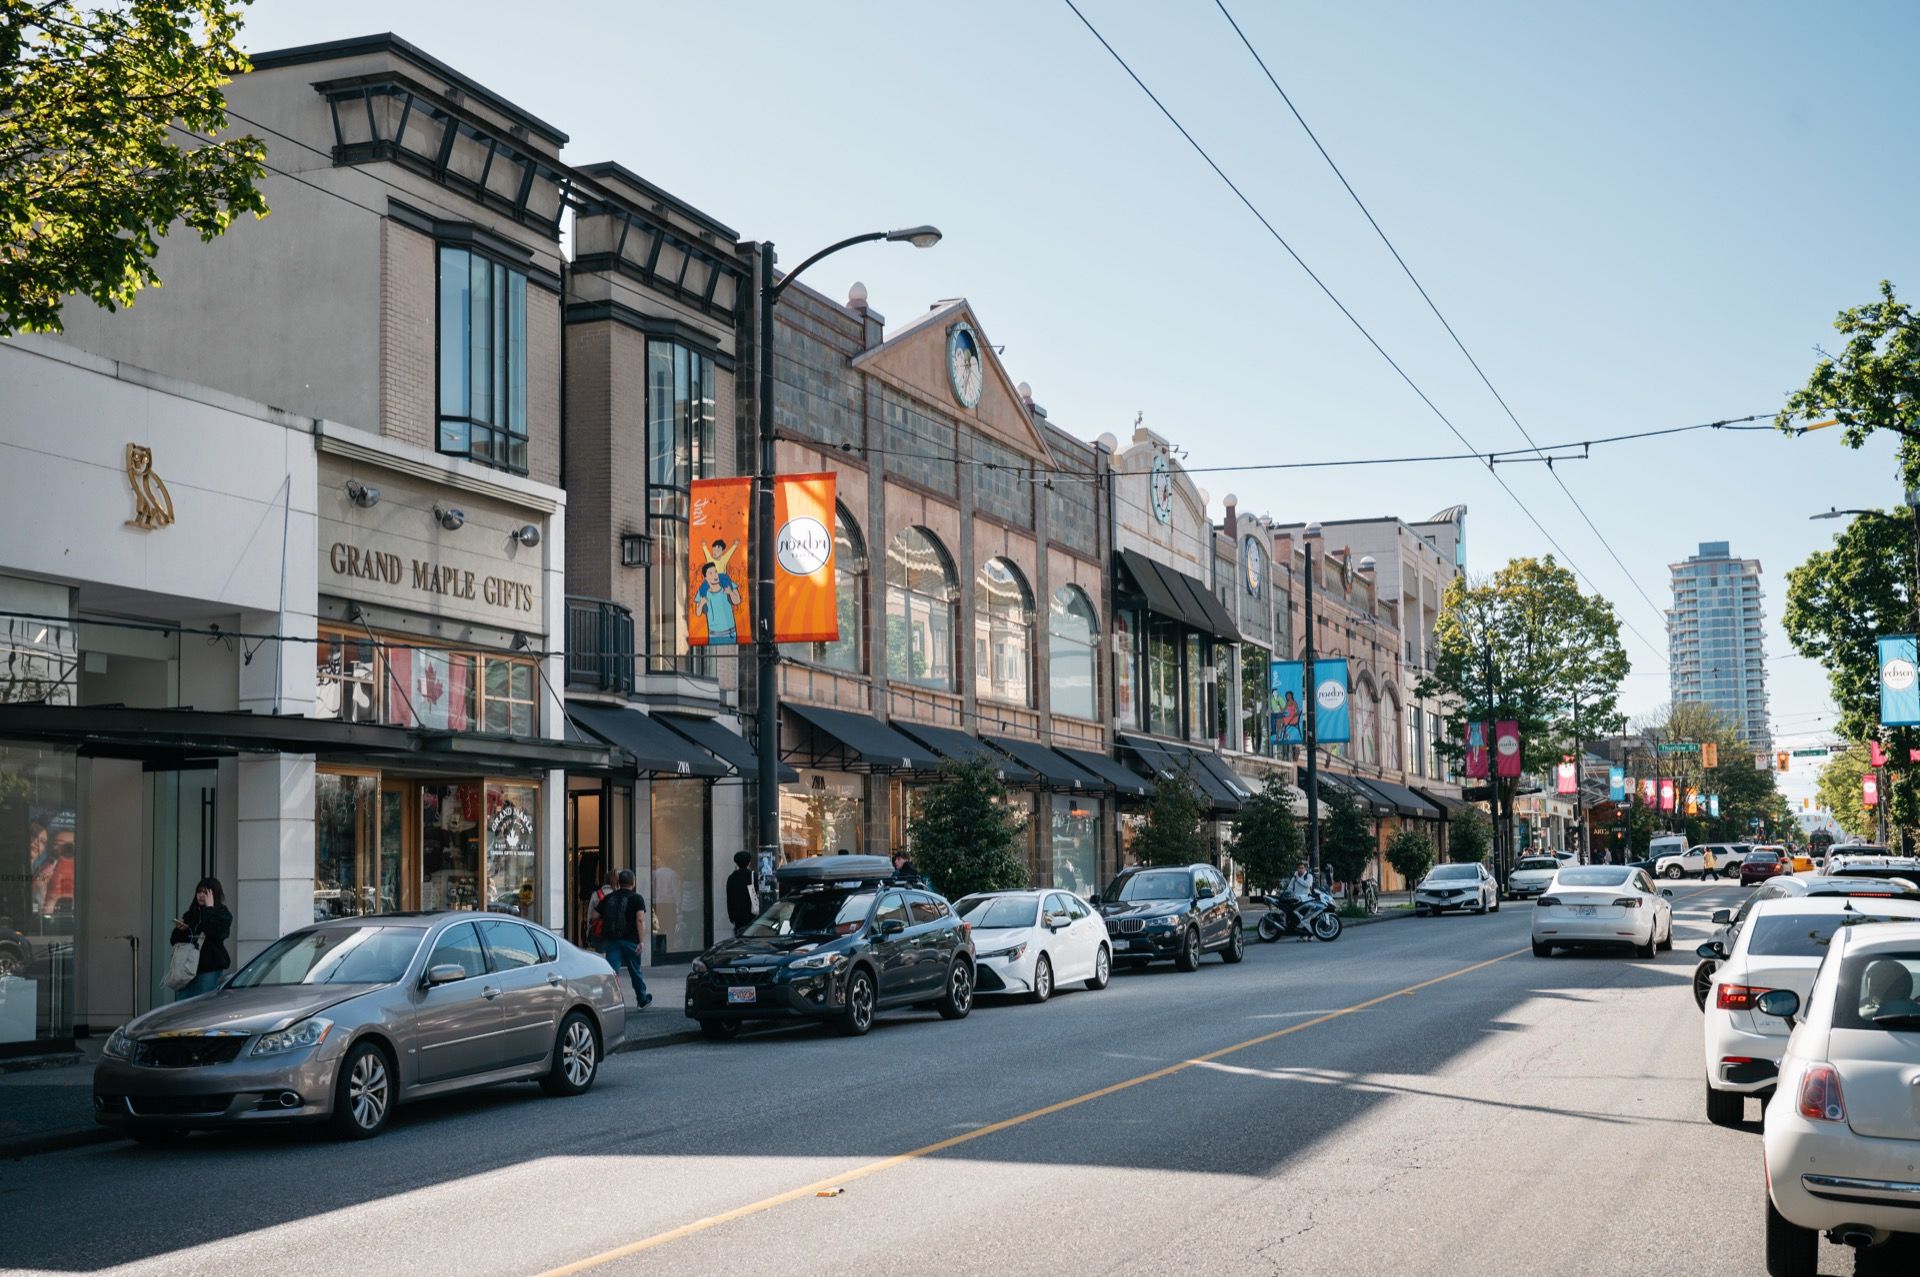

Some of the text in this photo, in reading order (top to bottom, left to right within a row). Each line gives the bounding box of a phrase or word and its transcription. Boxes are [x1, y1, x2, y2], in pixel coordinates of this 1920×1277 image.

[330, 542, 533, 612] GRAND MAPLE GIFTS
[491, 807, 513, 832] GRAND
[513, 807, 533, 835] MAPLE
